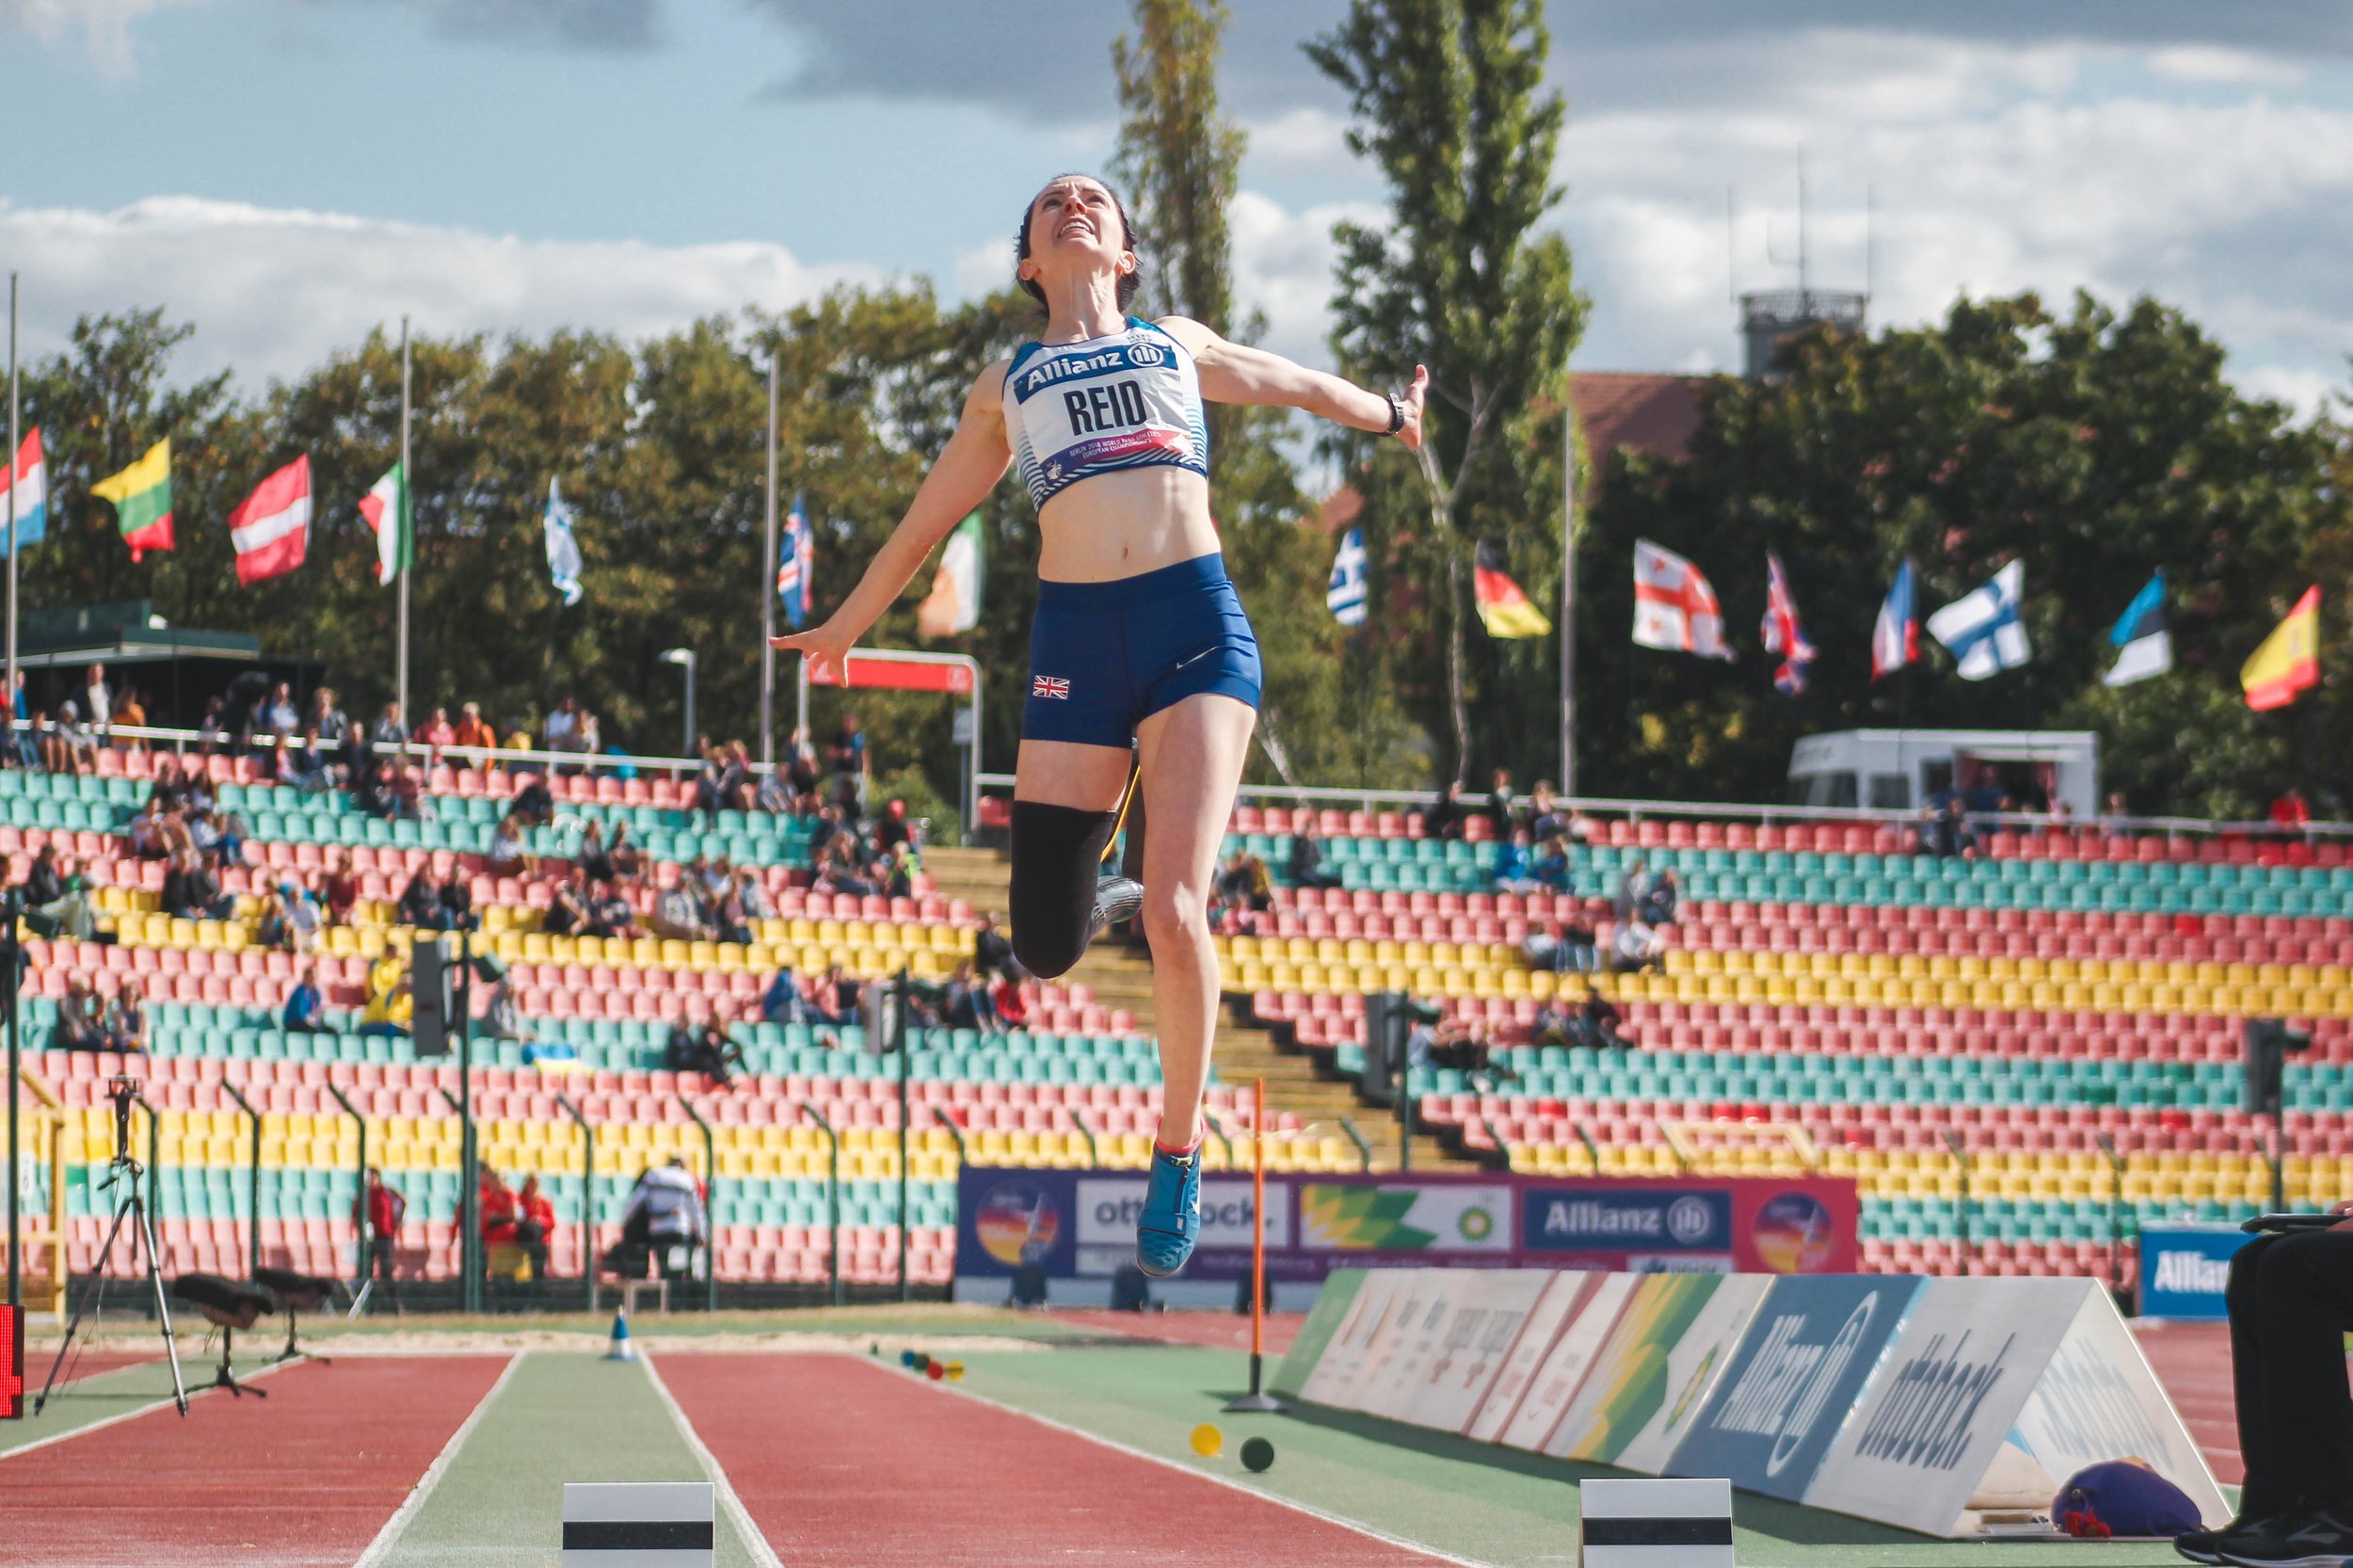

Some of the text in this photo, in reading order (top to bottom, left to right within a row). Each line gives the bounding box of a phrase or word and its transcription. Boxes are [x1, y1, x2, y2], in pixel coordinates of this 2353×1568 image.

[1028, 351, 1124, 392] Allianz
[1063, 379, 1147, 437] REID
[1069, 445, 1087, 457] BERLIN
[1088, 441, 1101, 450] 2018
[1101, 439, 1121, 448] WORLD
[1082, 447, 1109, 459] EUROPEAN
[1545, 1200, 1661, 1235] Allianz
[2153, 1250, 2229, 1293] Allian
[1710, 1314, 1825, 1435] Allianz
[1854, 1328, 2015, 1470] ottobock.
